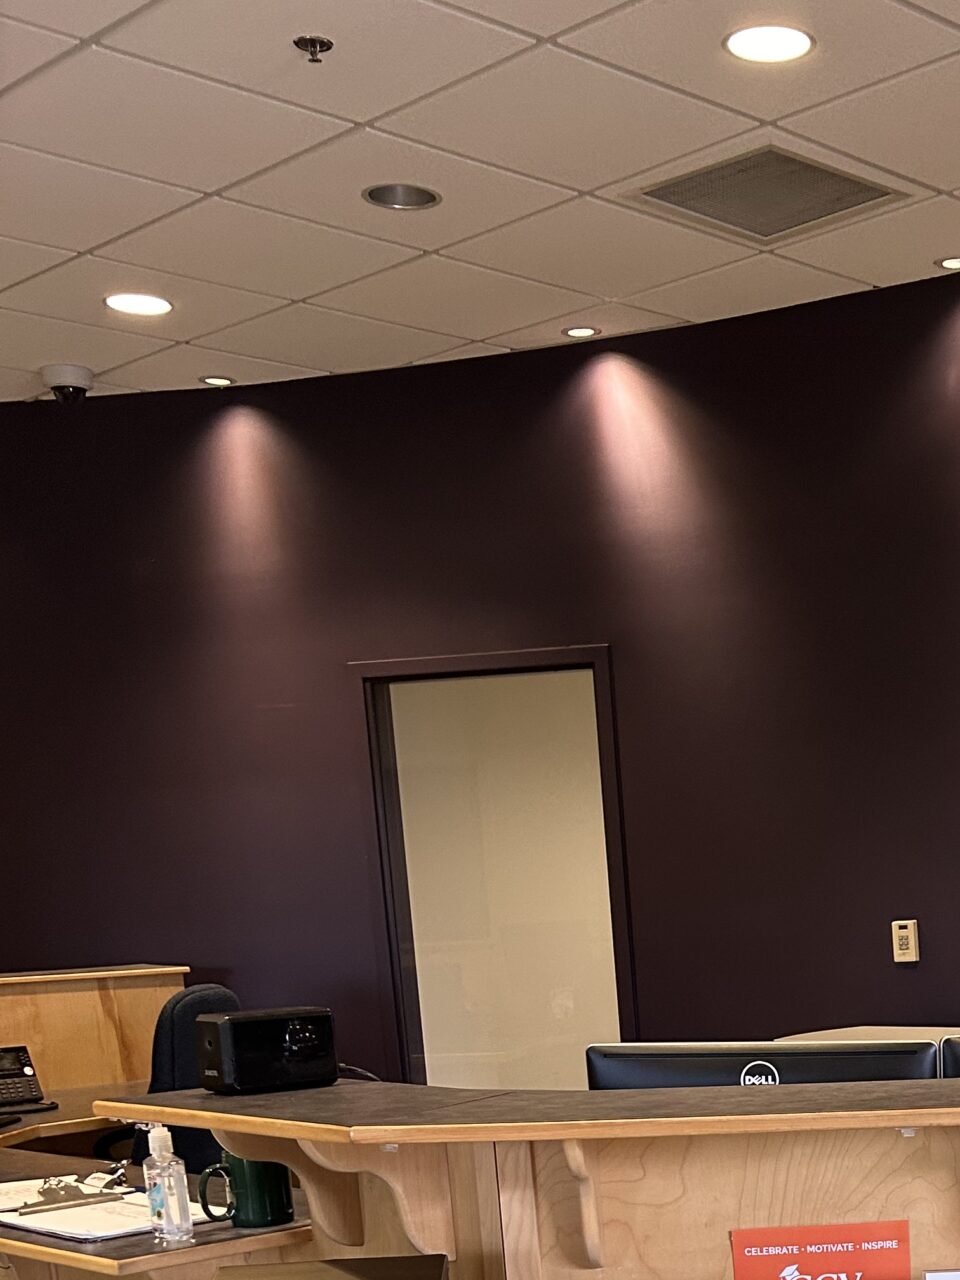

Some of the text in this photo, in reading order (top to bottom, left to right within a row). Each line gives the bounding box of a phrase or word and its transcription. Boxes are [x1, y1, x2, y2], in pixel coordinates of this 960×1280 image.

[745, 1075, 775, 1085] DELL
[745, 1240, 899, 1256] CELEBRATE MOTIVATE INSPIRE
